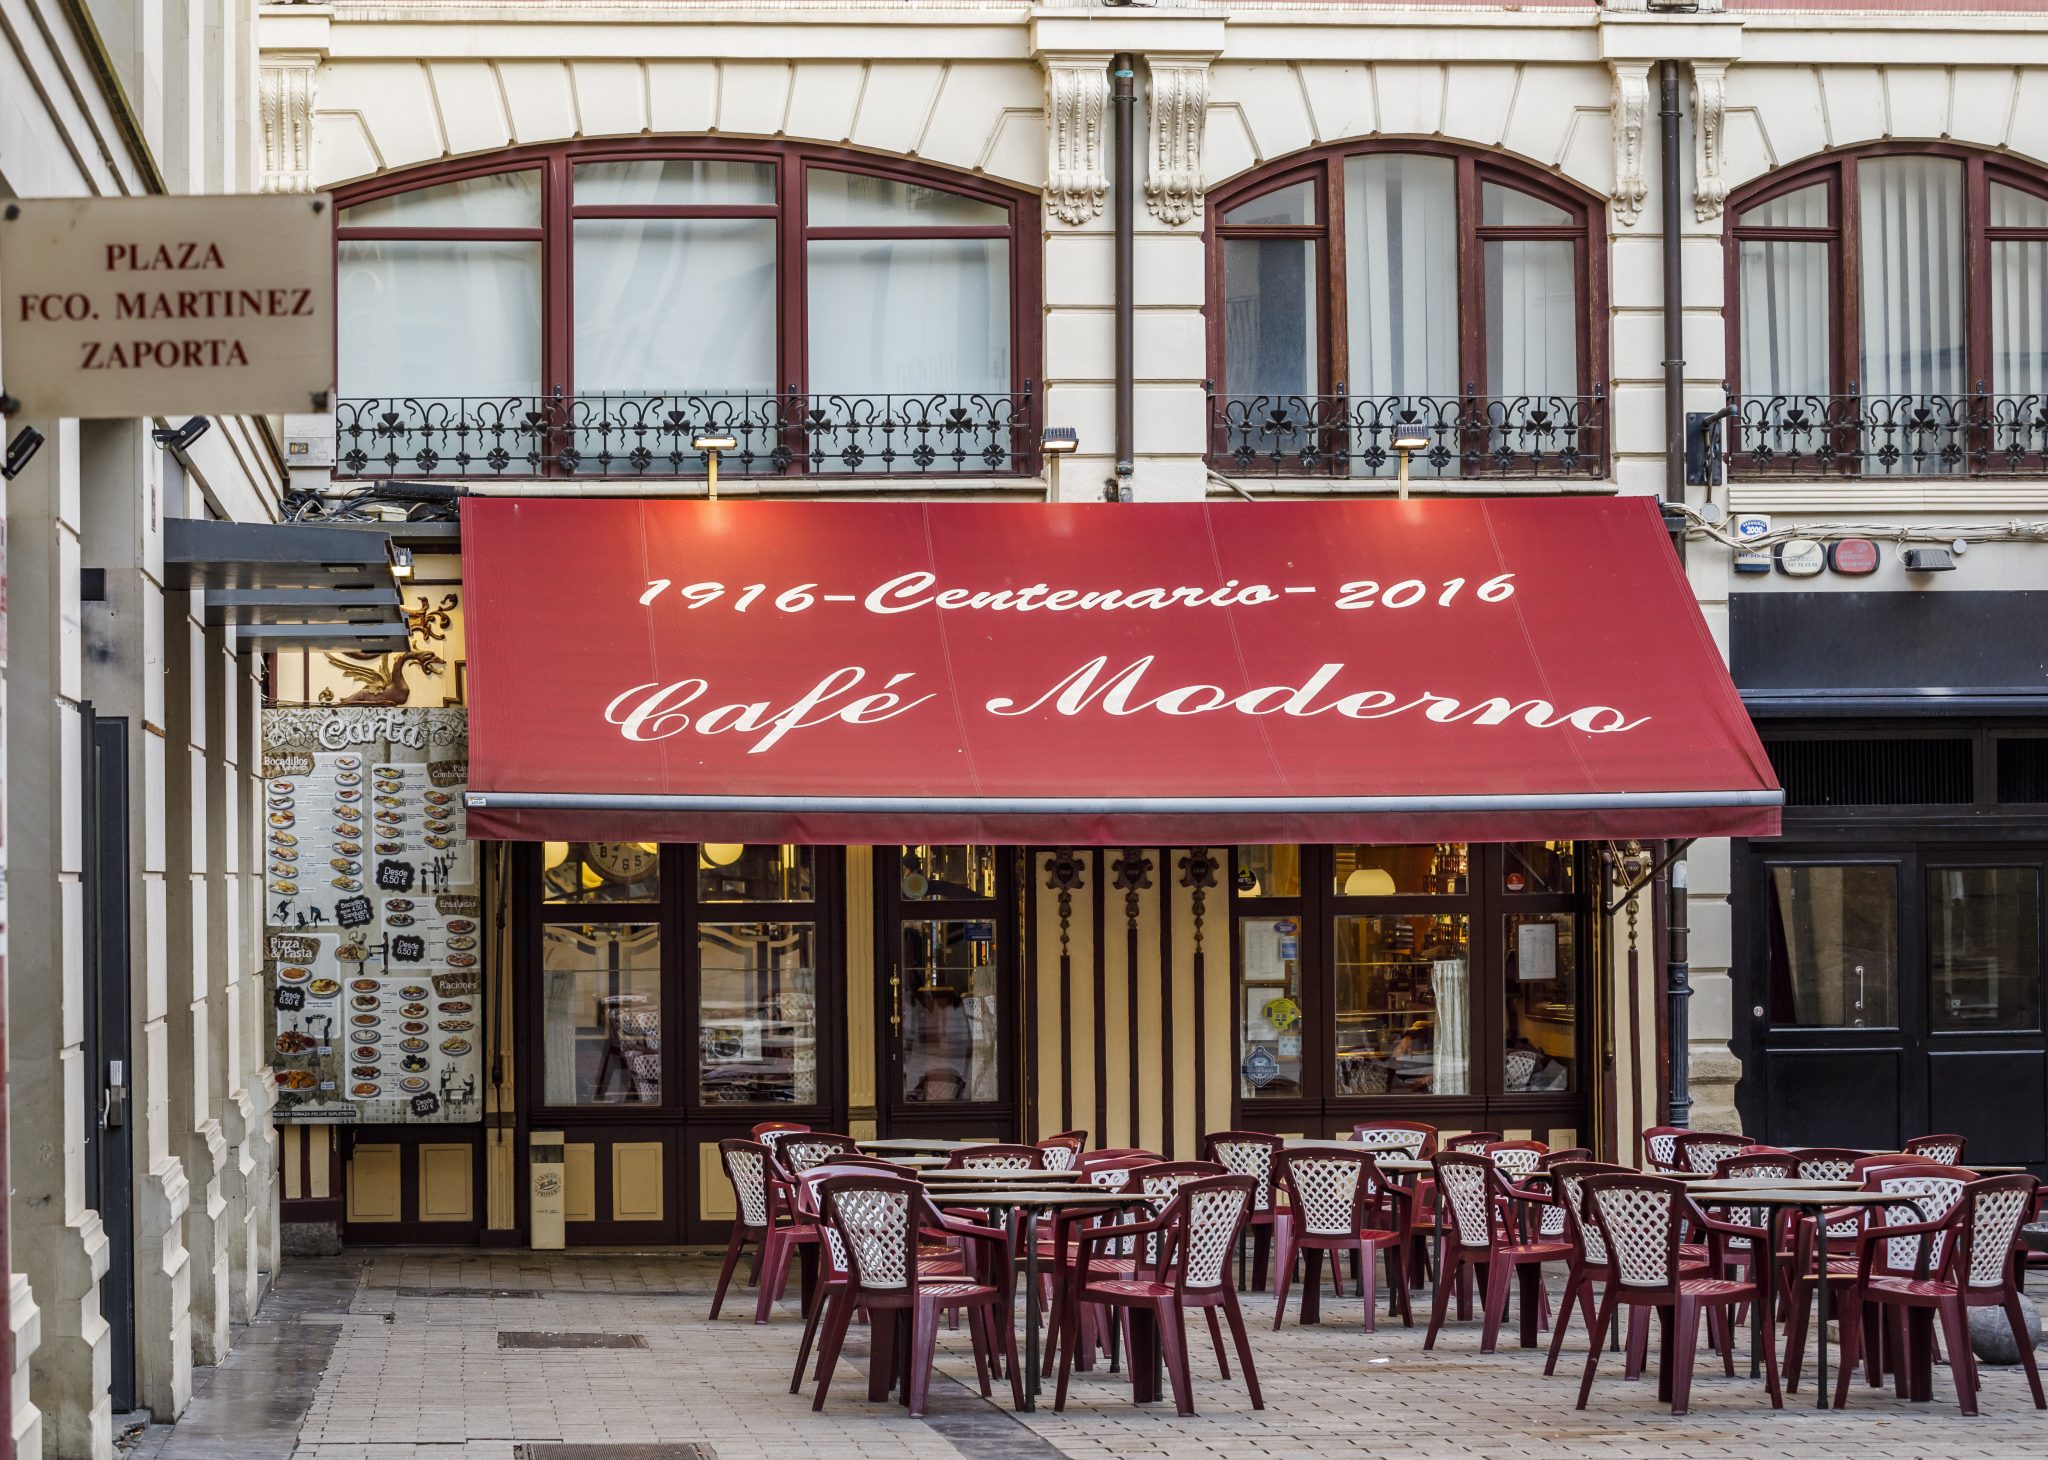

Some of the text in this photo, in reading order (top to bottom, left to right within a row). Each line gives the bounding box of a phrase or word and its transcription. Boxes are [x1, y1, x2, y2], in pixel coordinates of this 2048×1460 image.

[105, 242, 225, 271] PLAZA
[19, 289, 314, 322] FCO. MARTINEZ
[80, 339, 249, 370] ZAPORTA
[604, 655, 1652, 754] Café Moderno
[319, 711, 425, 750] Carta
[264, 757, 308, 767] Bocadillos
[600, 846, 607, 858] 8
[612, 856, 618, 867] 7
[622, 859, 629, 870] 6
[635, 855, 641, 866] 5
[384, 867, 408, 877] Desde
[383, 875, 399, 884] 6.50
[440, 900, 476, 908] Ensaladas
[270, 938, 300, 949] Pizza
[399, 940, 420, 950] Desde
[284, 948, 313, 958] Pasta
[440, 980, 477, 989] Raciones
[281, 990, 301, 999] Desde
